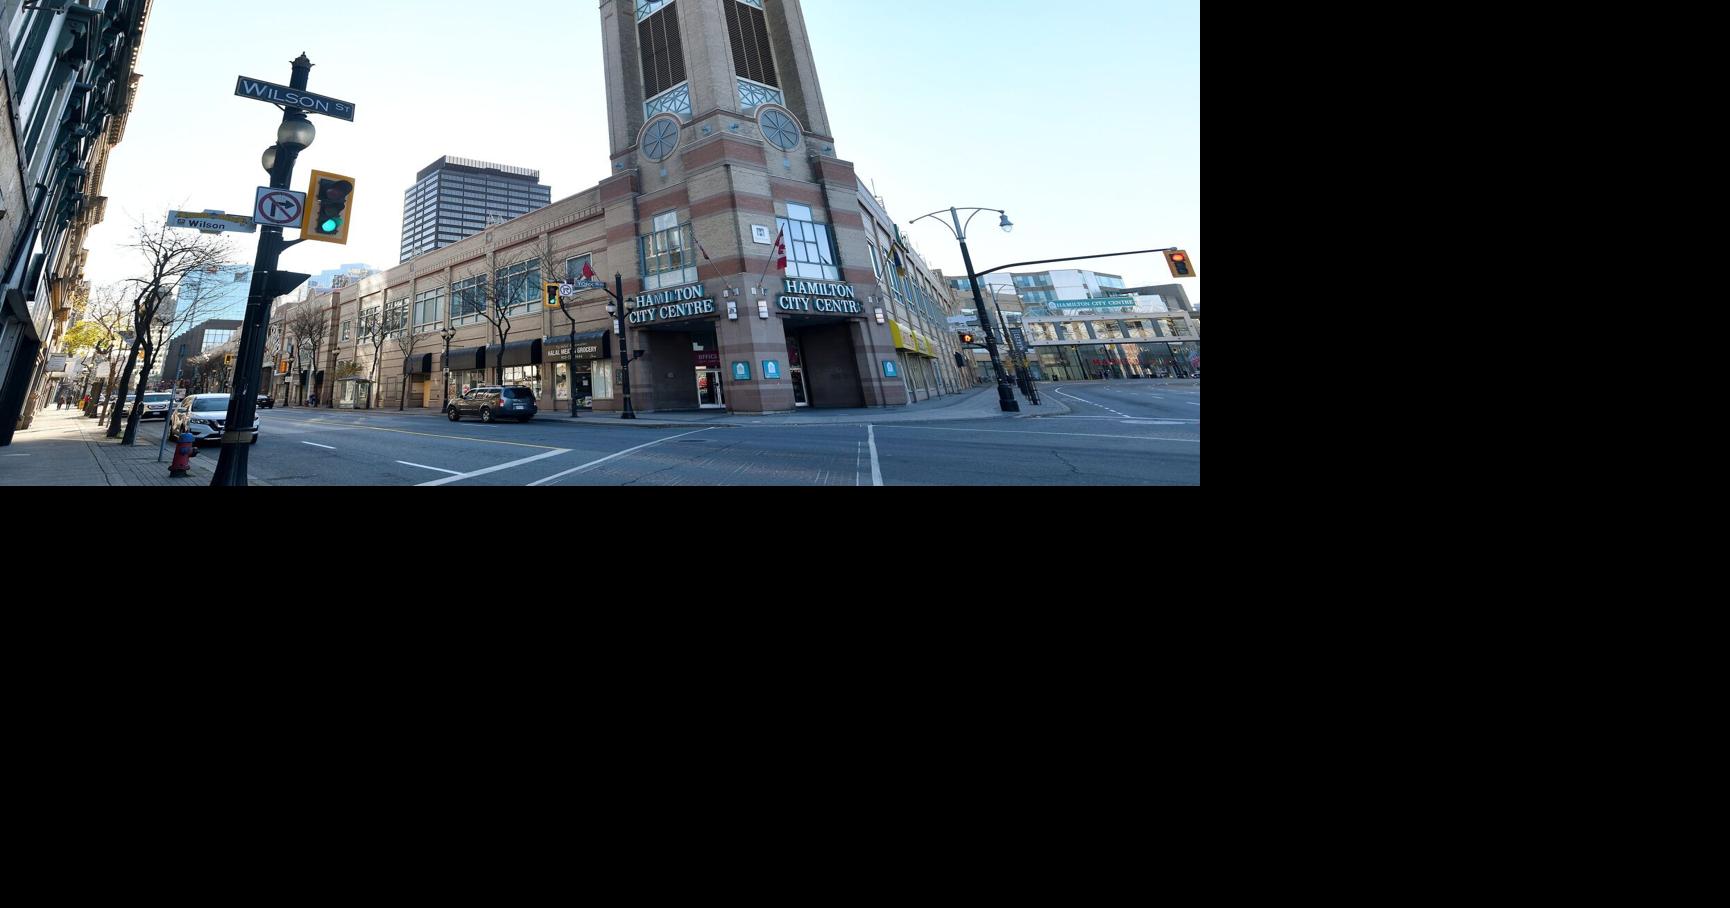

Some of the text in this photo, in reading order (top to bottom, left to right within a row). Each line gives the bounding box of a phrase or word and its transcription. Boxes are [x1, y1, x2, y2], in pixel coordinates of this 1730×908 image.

[243, 80, 351, 113] WILSON ST
[188, 219, 226, 230] Wilson
[785, 280, 855, 297] HAMILTON
[629, 299, 714, 324] CITY CENTRE
[780, 296, 862, 313] CITY CENTR
[560, 347, 572, 355] MEA
[576, 345, 598, 354] GROCERY
